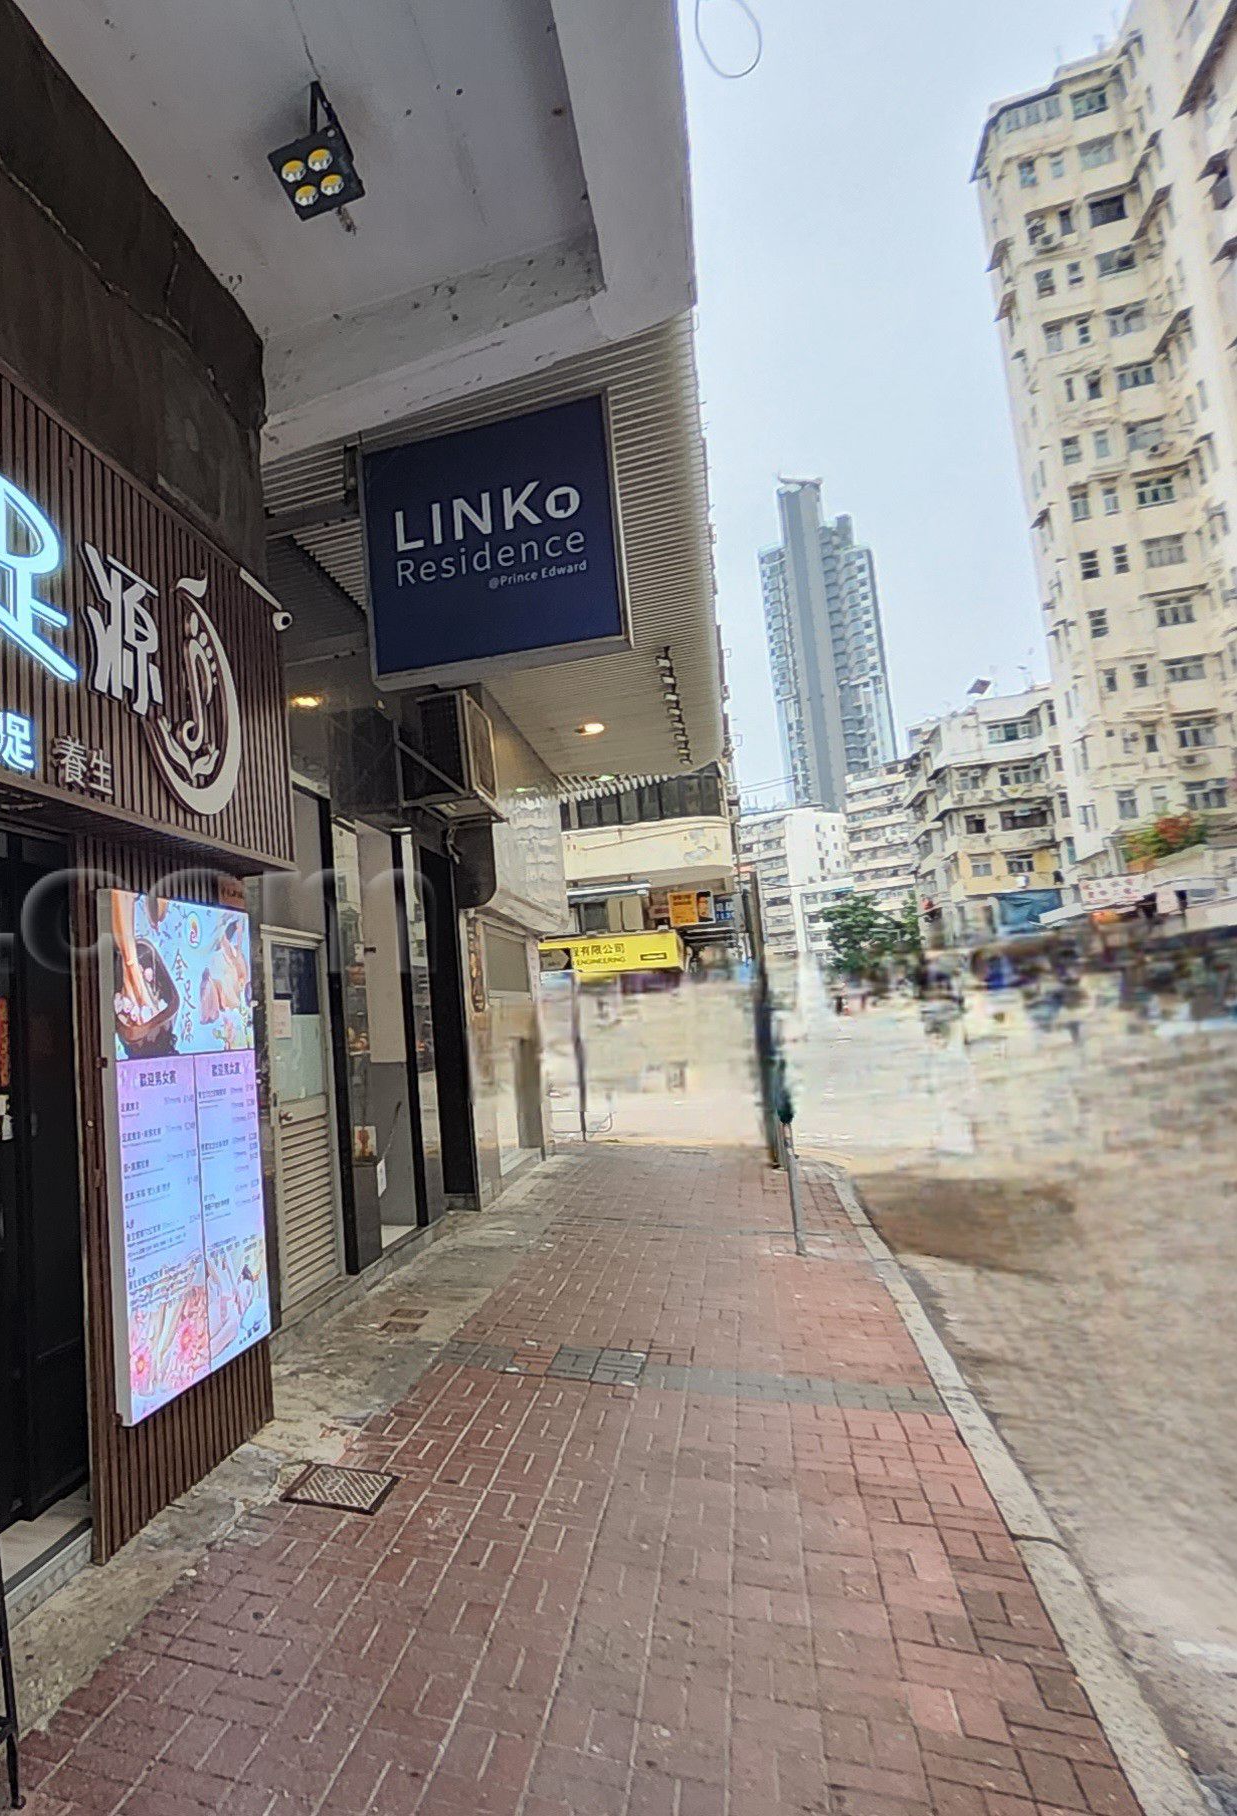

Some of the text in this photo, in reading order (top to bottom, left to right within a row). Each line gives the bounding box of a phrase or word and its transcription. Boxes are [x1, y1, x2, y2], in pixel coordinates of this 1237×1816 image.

[396, 530, 586, 587] Residence
[488, 559, 588, 590] @Prince Edward
[51, 735, 115, 799] 養生
